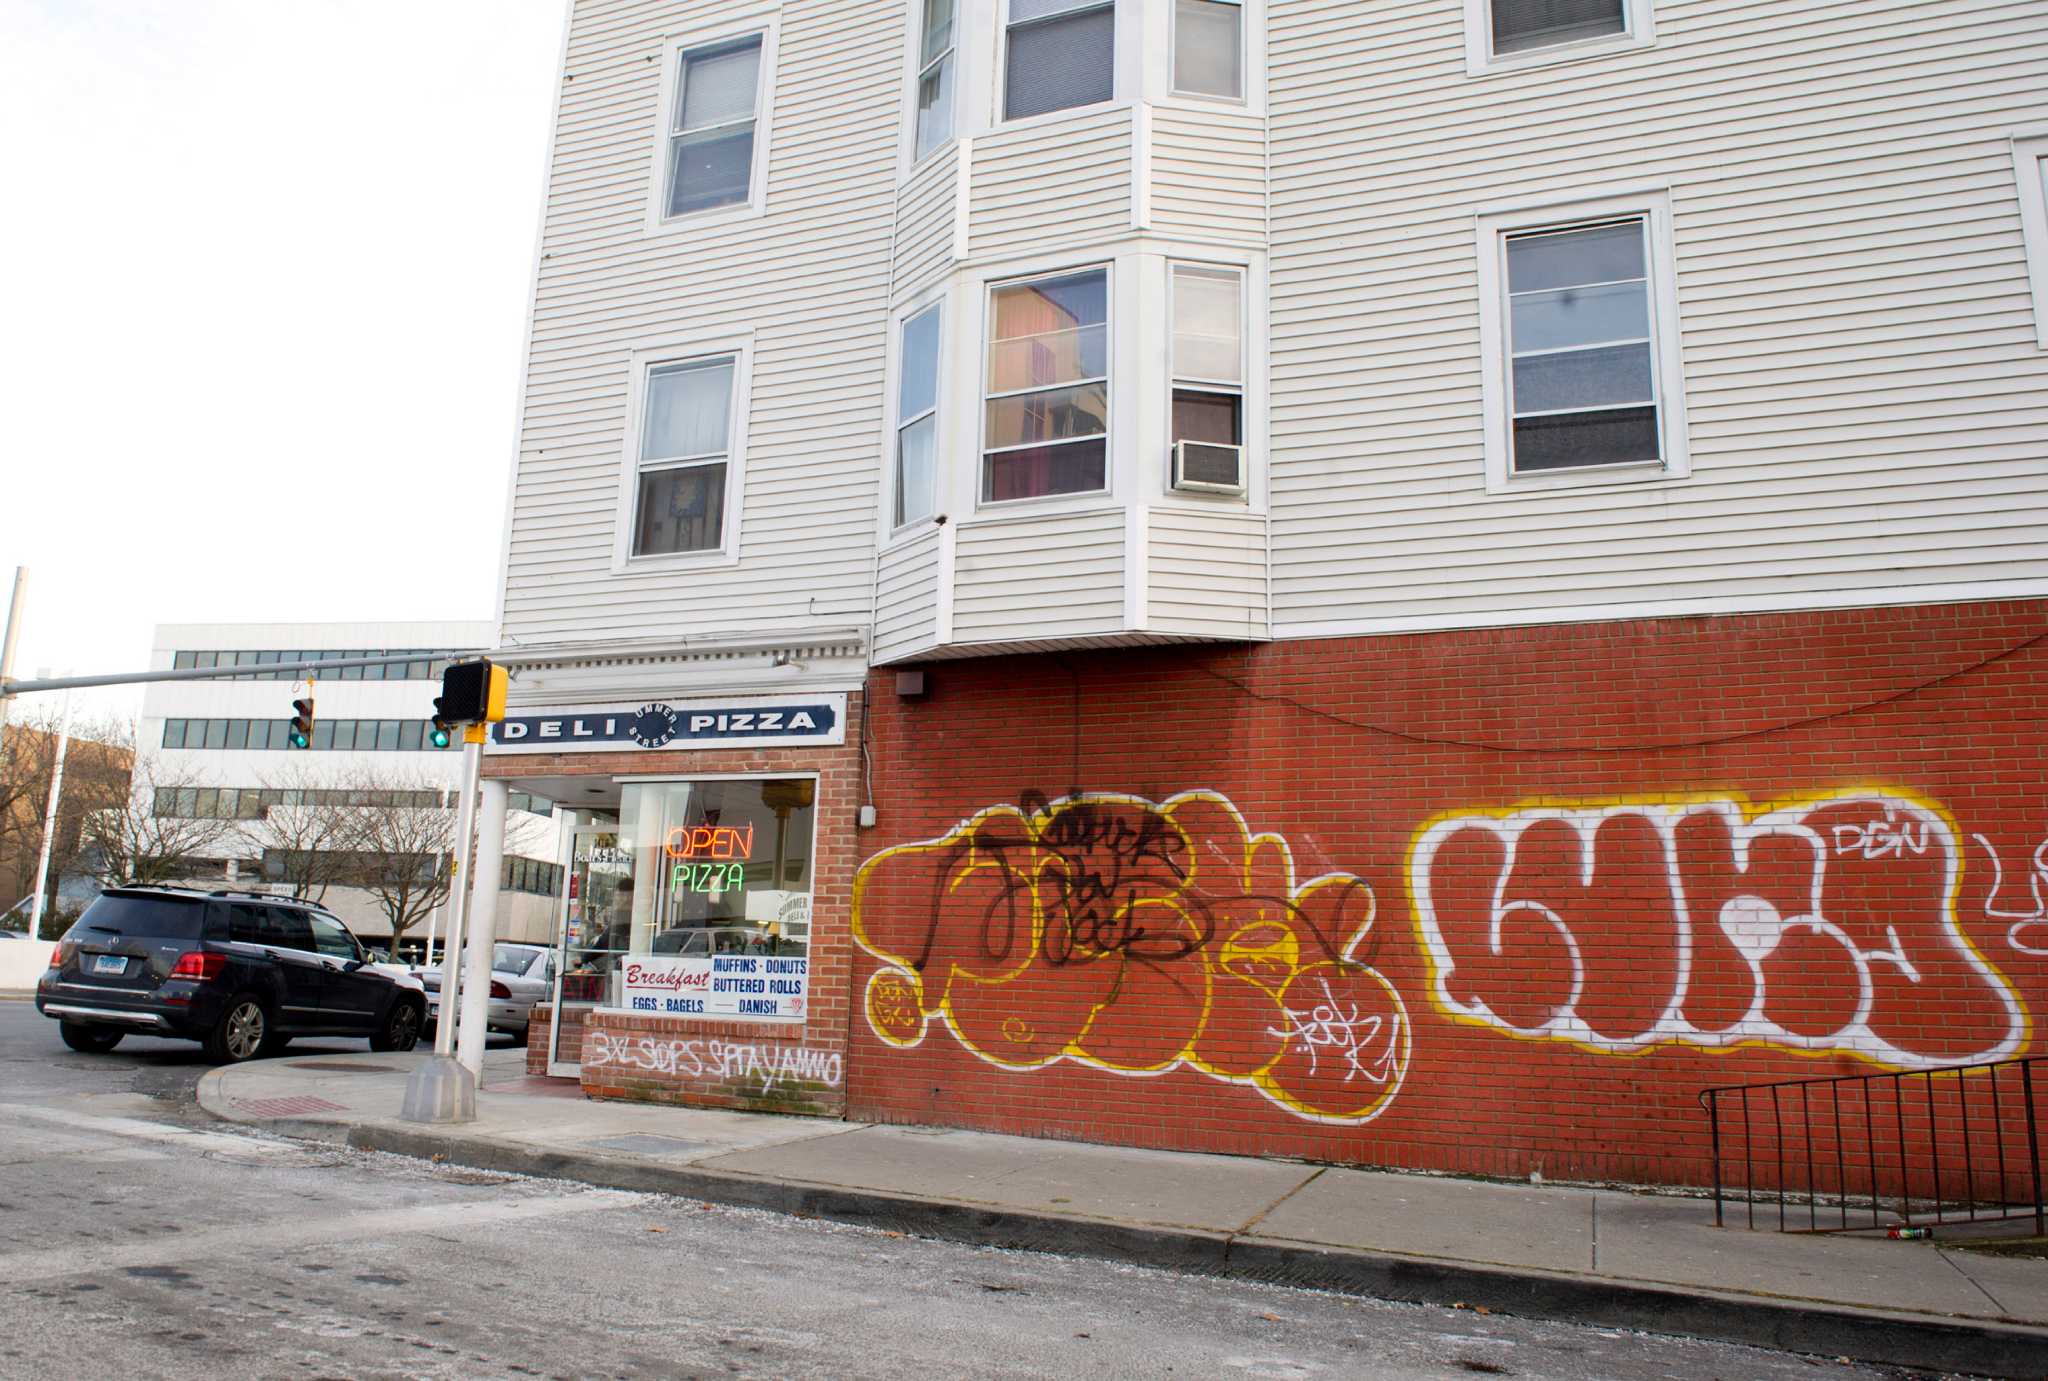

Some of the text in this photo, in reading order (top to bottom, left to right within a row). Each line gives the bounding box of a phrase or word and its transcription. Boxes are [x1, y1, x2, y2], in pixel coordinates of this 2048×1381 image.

[503, 711, 816, 739] DELI PIZZA
[629, 726, 676, 748] STREET
[666, 827, 753, 858] OPEN
[671, 863, 744, 893] PIZZA
[713, 958, 807, 974] MUFFINS DONUTS
[626, 964, 711, 992] Breakfast
[713, 978, 801, 994] BUTTERED ROLLS
[633, 997, 704, 1013] EGGS BAGELS
[739, 999, 777, 1014] DANISH
